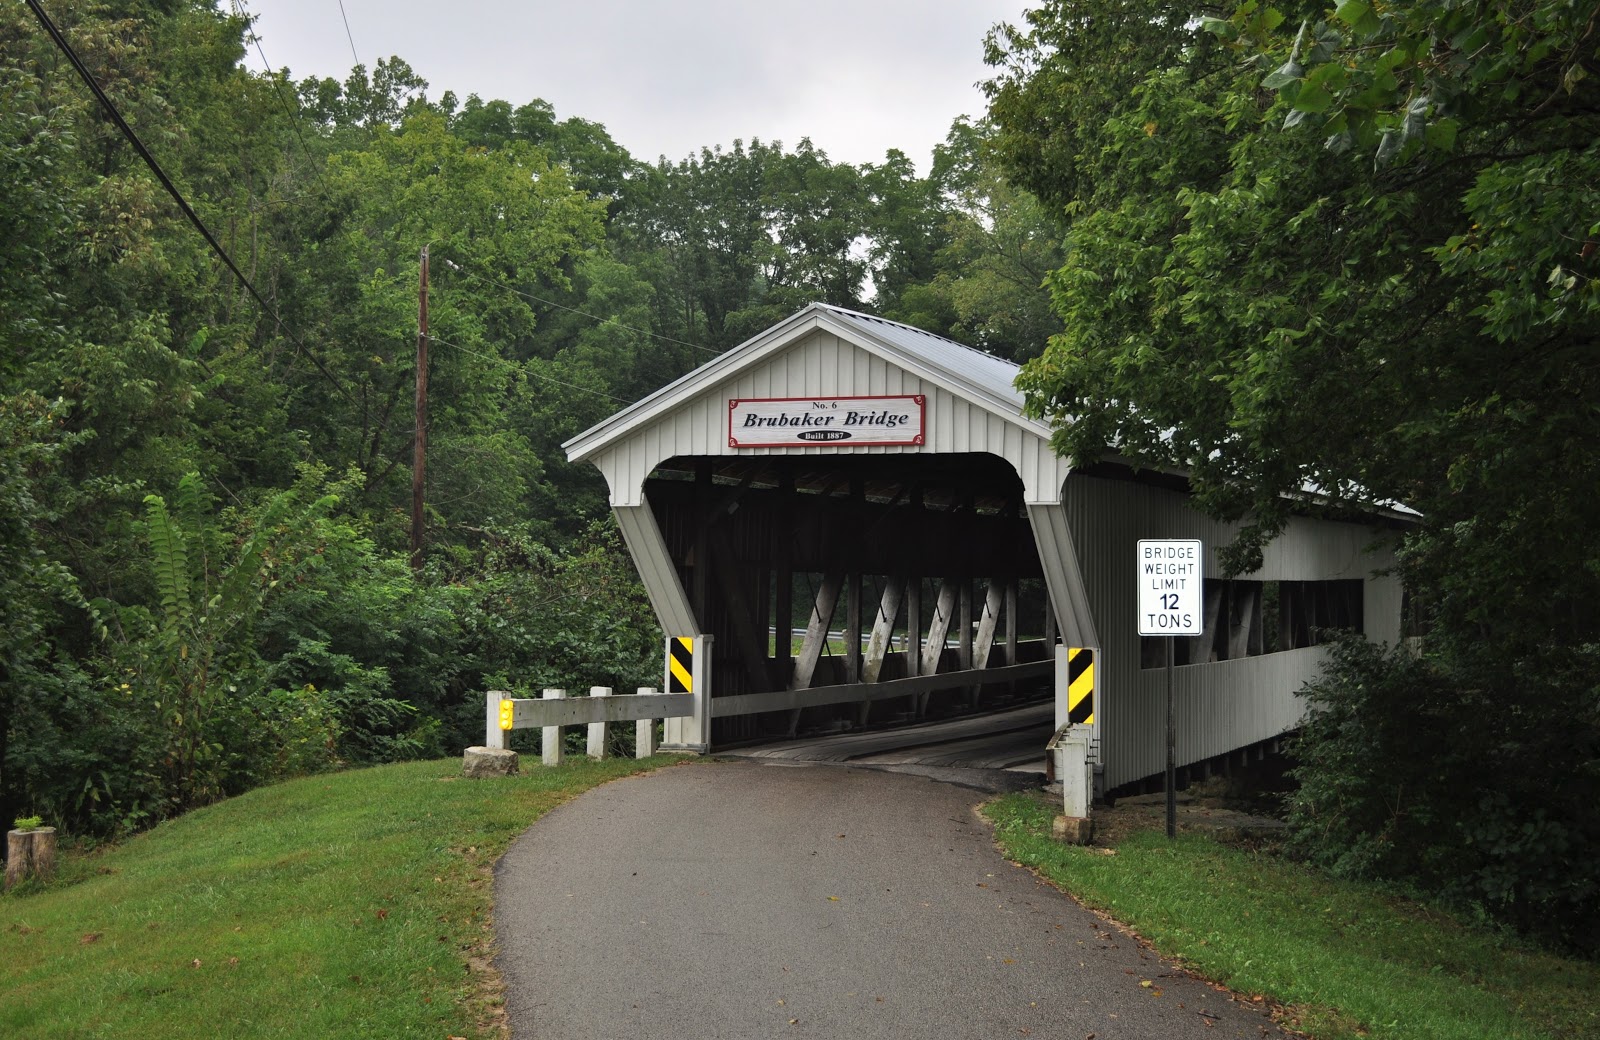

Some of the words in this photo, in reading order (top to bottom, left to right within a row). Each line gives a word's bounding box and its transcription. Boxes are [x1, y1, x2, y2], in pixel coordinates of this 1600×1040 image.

[812, 401, 828, 410] No.
[831, 401, 837, 410] 6
[743, 412, 834, 428] Brubaker
[843, 410, 909, 427] Bridge
[805, 432, 825, 440] Built
[827, 432, 844, 440] 1887
[1144, 547, 1194, 559] BRIDGE
[1144, 563, 1194, 575] WEIGHT
[1152, 578, 1187, 590] LIMIT
[1159, 593, 1180, 610] 12
[1147, 613, 1193, 628] TONS
